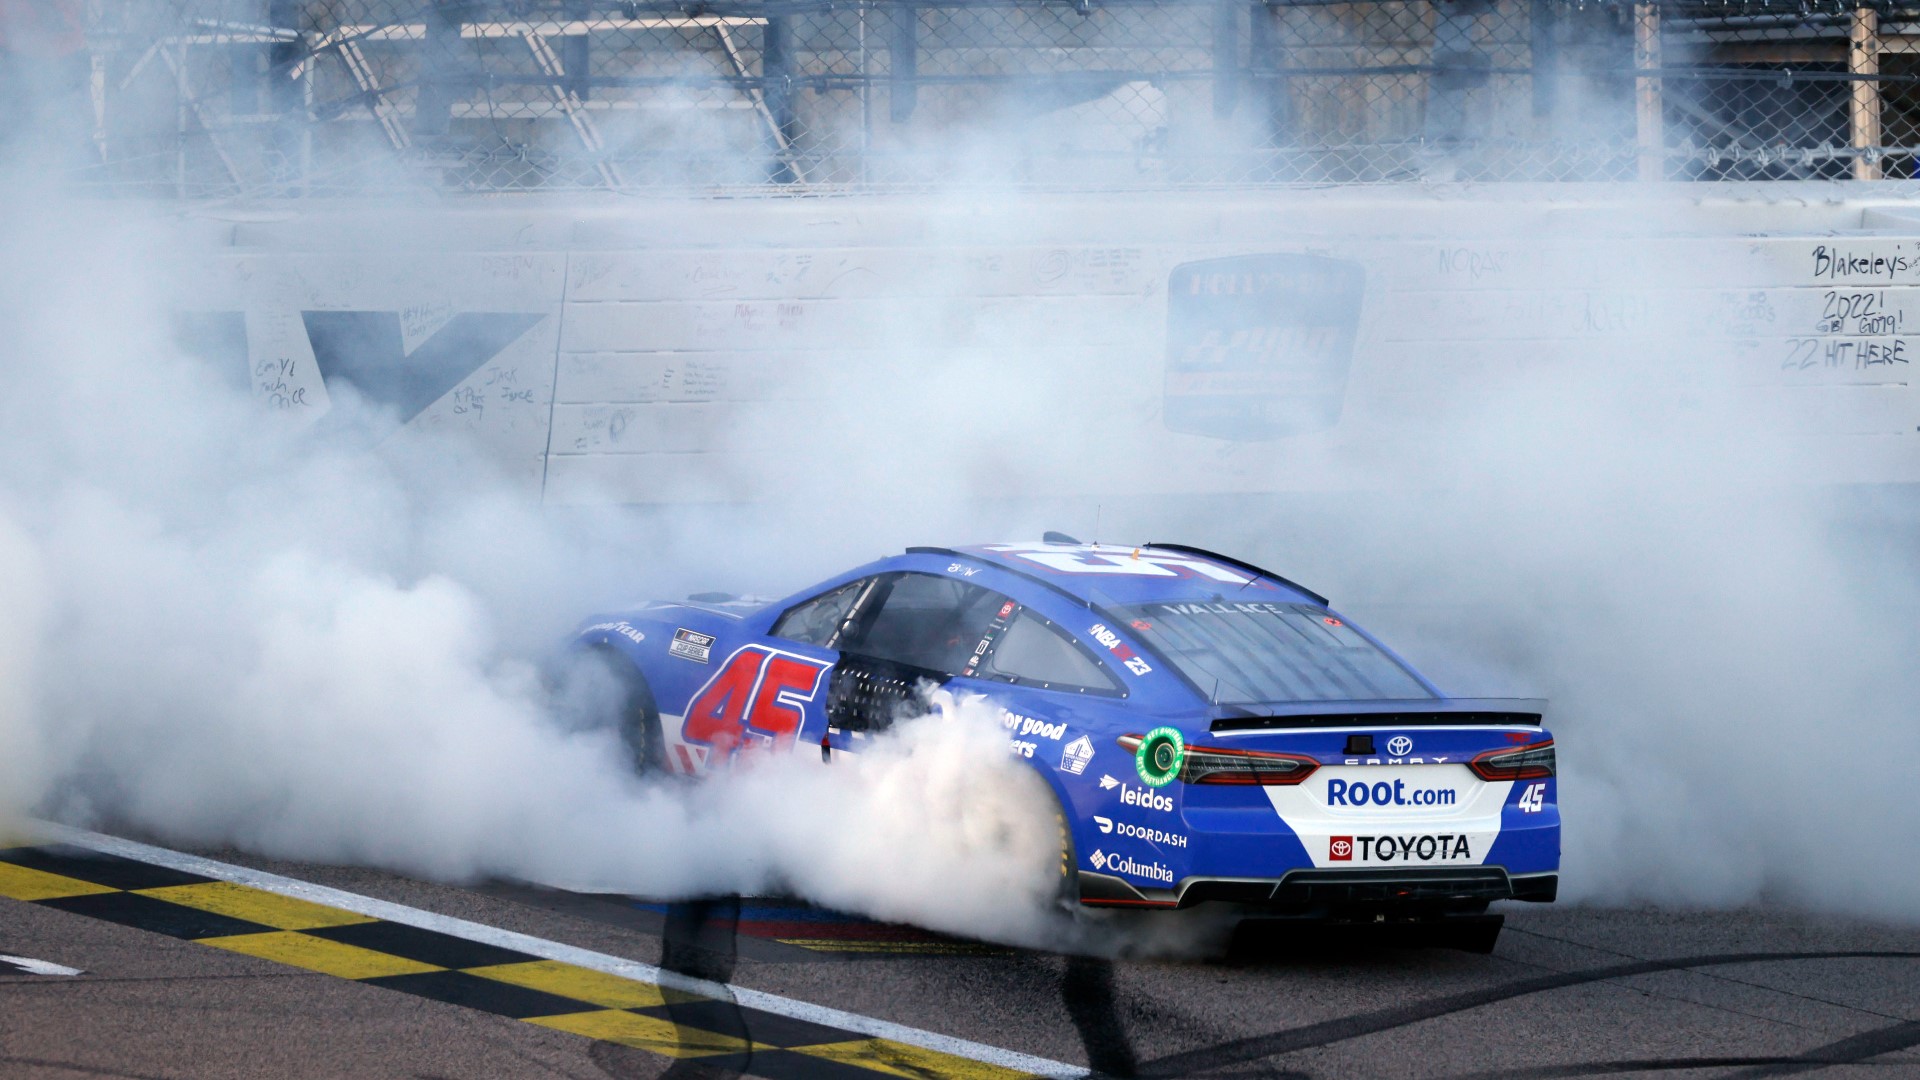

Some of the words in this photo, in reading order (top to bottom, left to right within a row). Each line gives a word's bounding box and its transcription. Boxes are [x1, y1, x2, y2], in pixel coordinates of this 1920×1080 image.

[1812, 245, 1908, 280] Blakeley's
[1855, 339, 1909, 370] HERE
[682, 644, 830, 765] 45
[1020, 717, 1068, 741] good
[1119, 783, 1173, 812] leidos
[1328, 778, 1456, 806] Root.com
[1518, 783, 1546, 813] 45
[1116, 822, 1187, 849] DOORDASH
[1356, 834, 1471, 862] TOYOTA
[1106, 853, 1173, 883] Columbia
